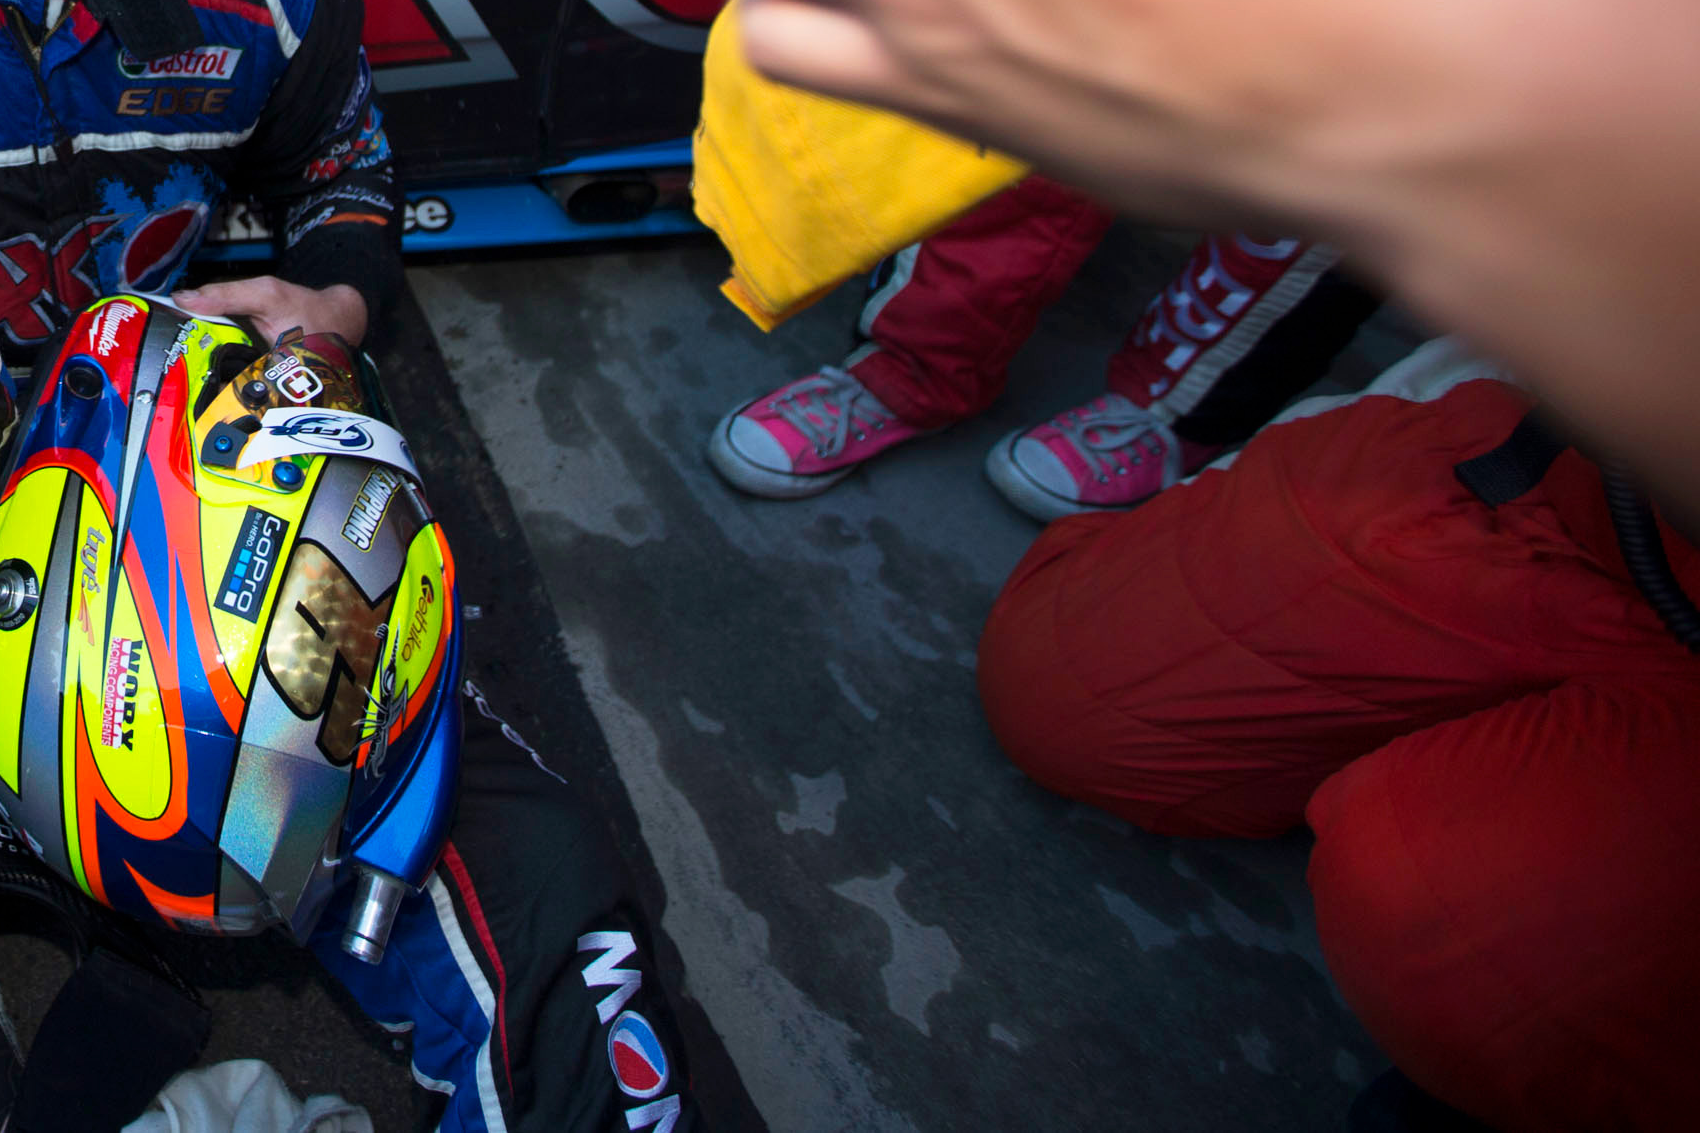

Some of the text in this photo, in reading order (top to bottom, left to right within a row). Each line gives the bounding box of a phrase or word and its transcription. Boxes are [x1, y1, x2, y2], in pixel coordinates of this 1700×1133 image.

[116, 86, 233, 116] EDGE
[237, 516, 281, 612] GoPro
[101, 637, 121, 746] RACING COMPONENTS
[112, 639, 143, 751] WORX
